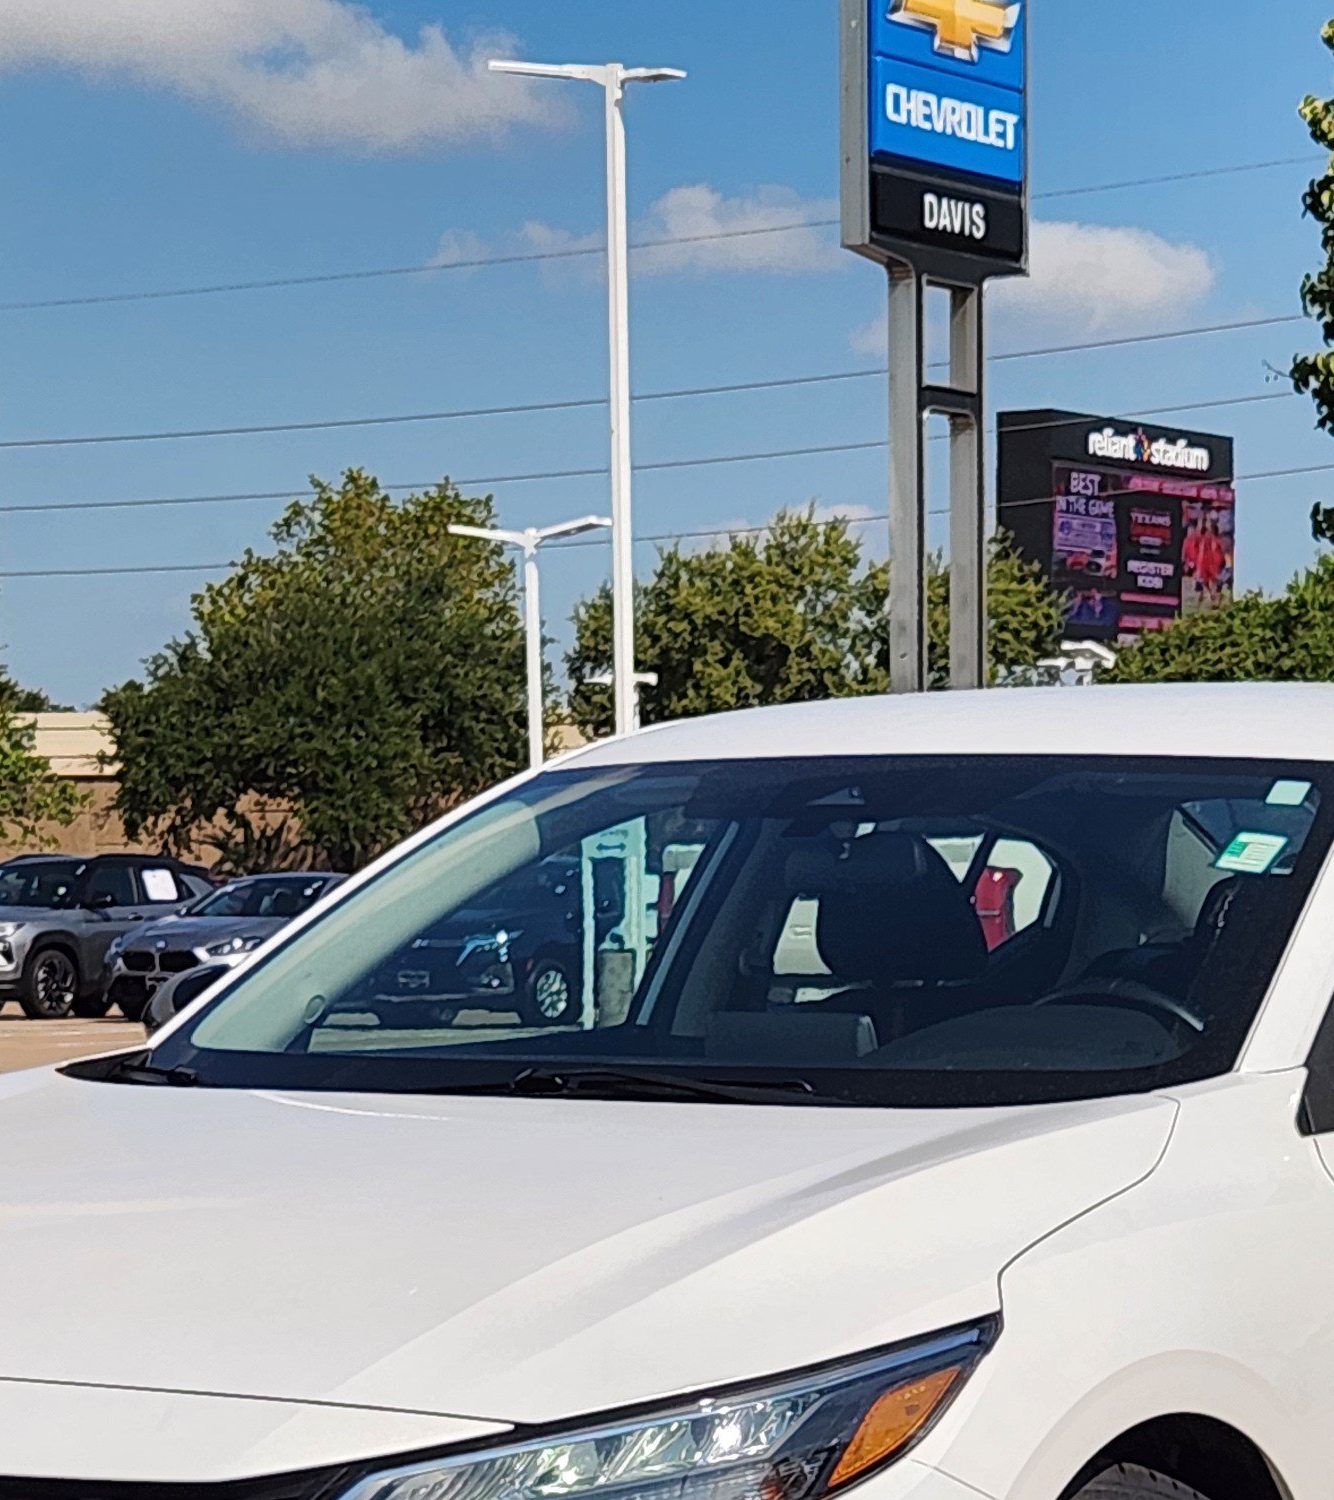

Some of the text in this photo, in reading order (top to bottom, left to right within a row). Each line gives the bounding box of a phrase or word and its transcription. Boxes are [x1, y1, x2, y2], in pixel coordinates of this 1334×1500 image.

[886, 83, 1020, 150] CHEVROLET
[923, 192, 986, 240] DAVIS
[1088, 427, 1209, 472] reliant stadium
[1070, 471, 1101, 496] BEST
